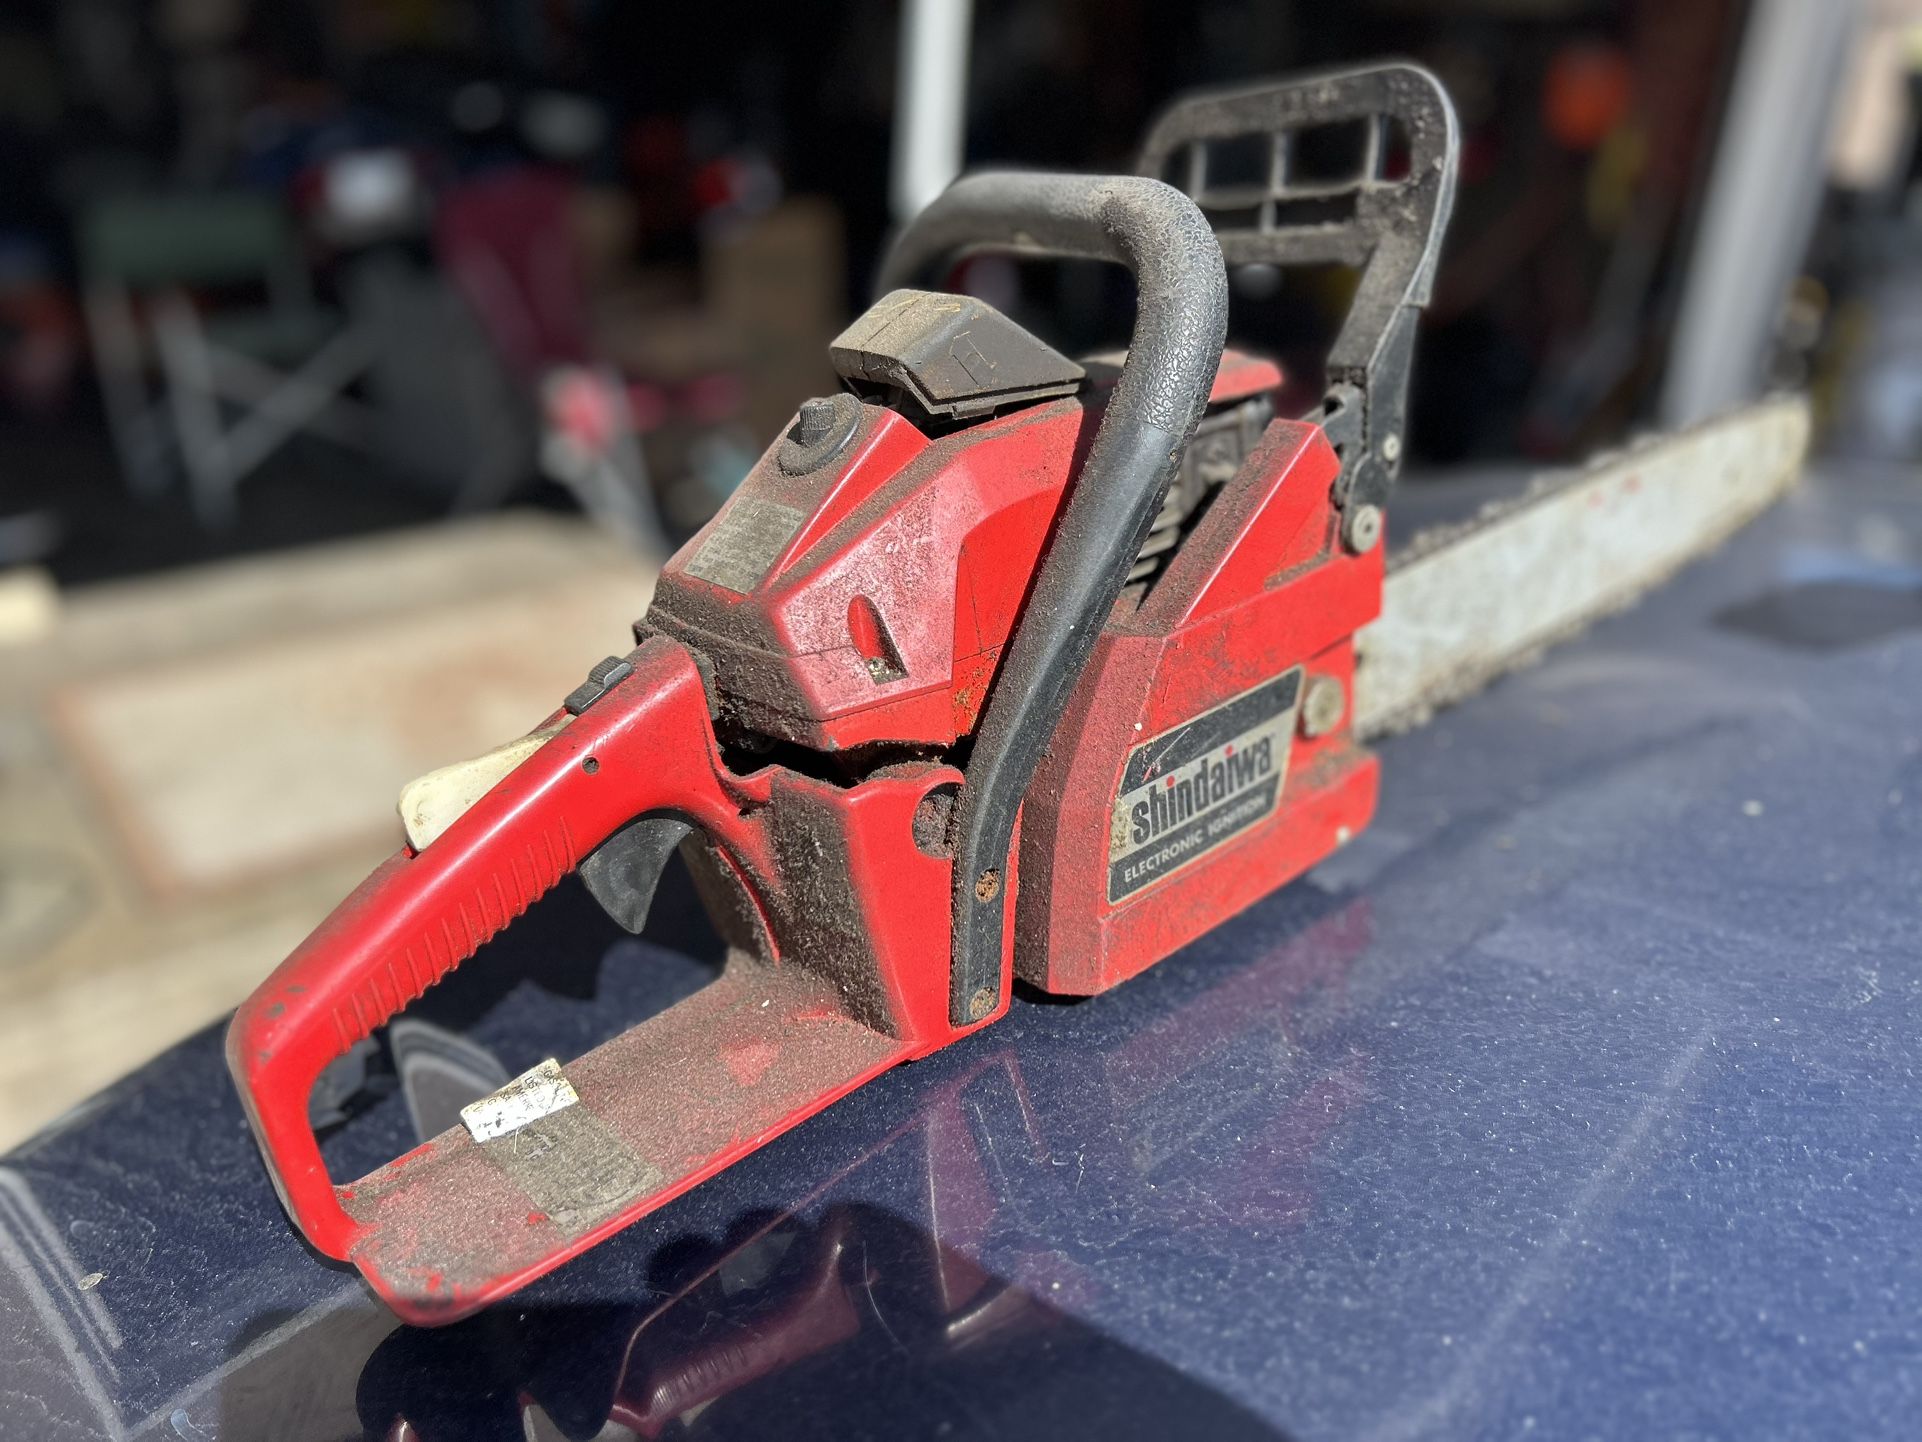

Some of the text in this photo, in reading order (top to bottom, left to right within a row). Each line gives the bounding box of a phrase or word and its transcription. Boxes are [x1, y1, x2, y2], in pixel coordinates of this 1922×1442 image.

[1124, 793, 1267, 883] ELECTRONIC IGNITION
[1131, 737, 1271, 845] shindaiwa
